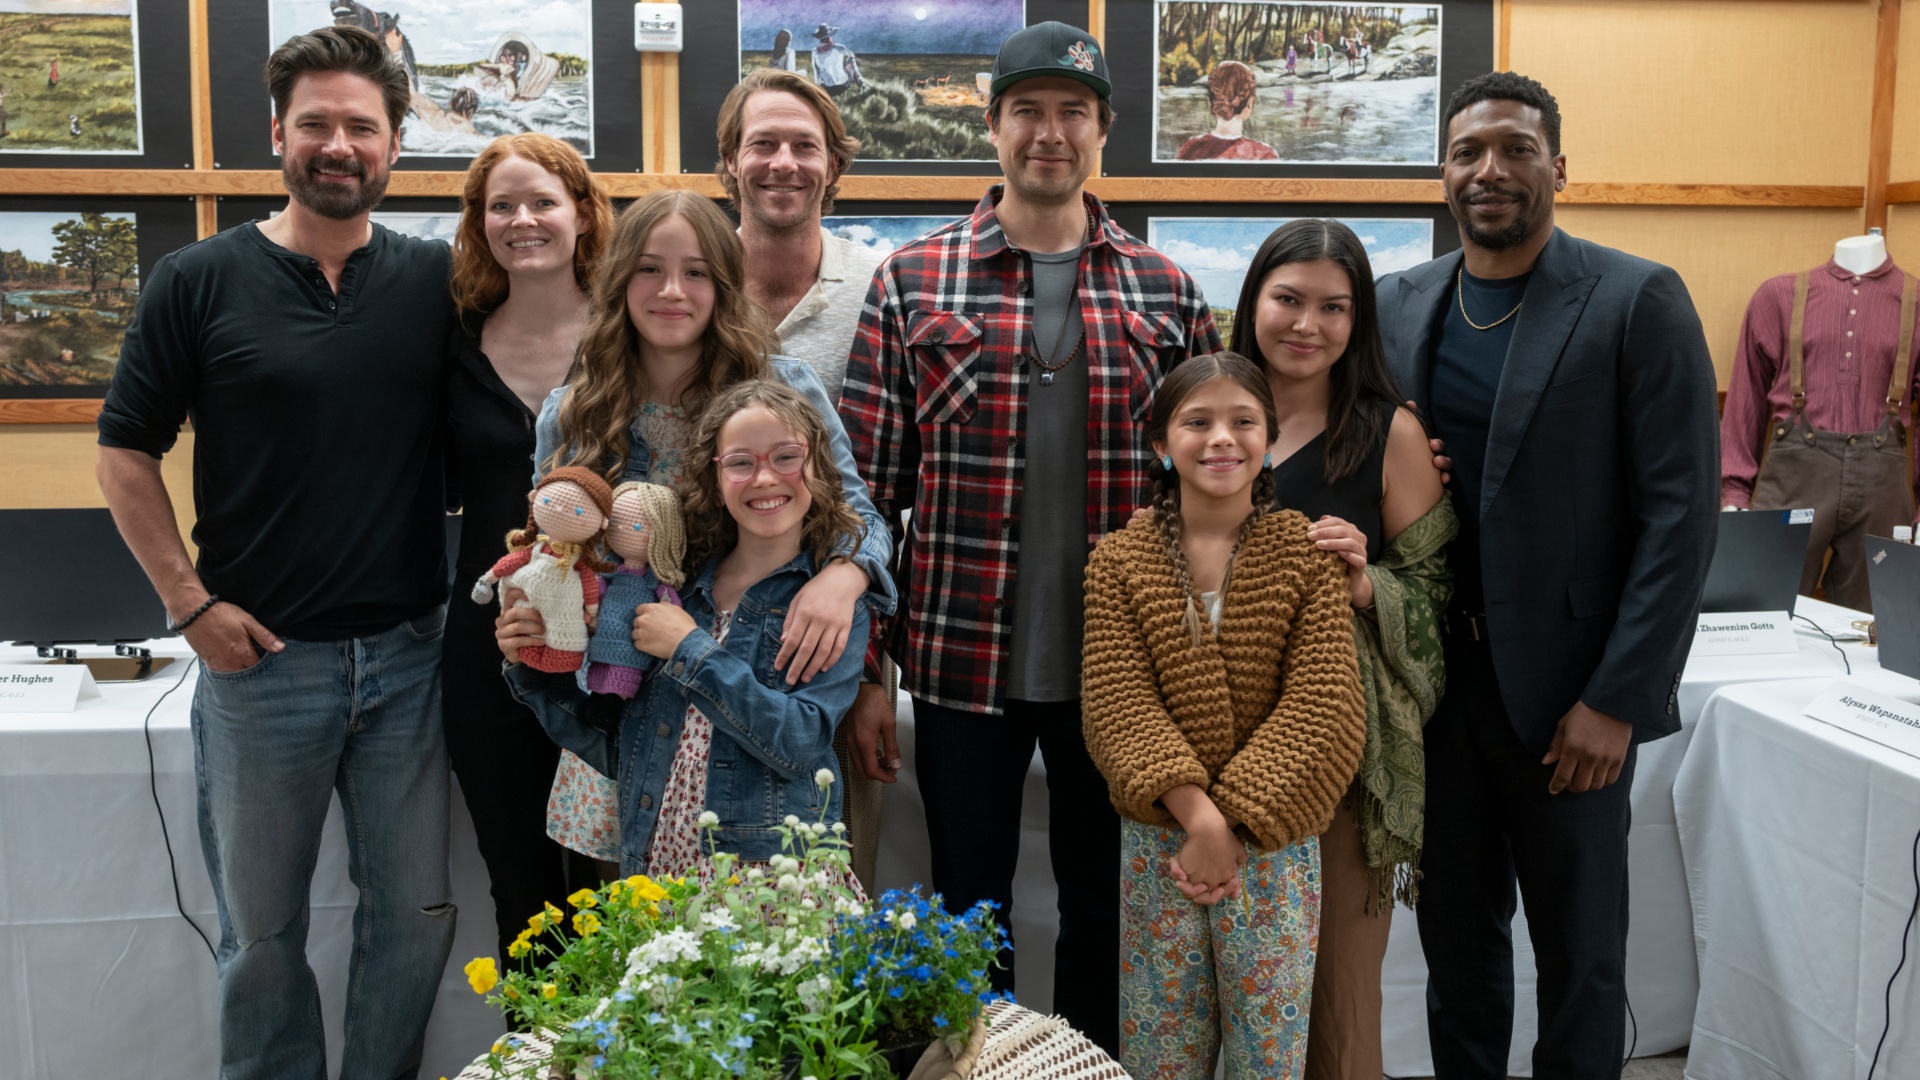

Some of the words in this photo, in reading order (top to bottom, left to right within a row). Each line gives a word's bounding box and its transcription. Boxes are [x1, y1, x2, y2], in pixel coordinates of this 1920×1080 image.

[1699, 623, 1749, 632] Zhawenim
[1750, 622, 1775, 630] Gotts
[11, 674, 54, 685] Hughes
[1839, 696, 1868, 709] Alyssa
